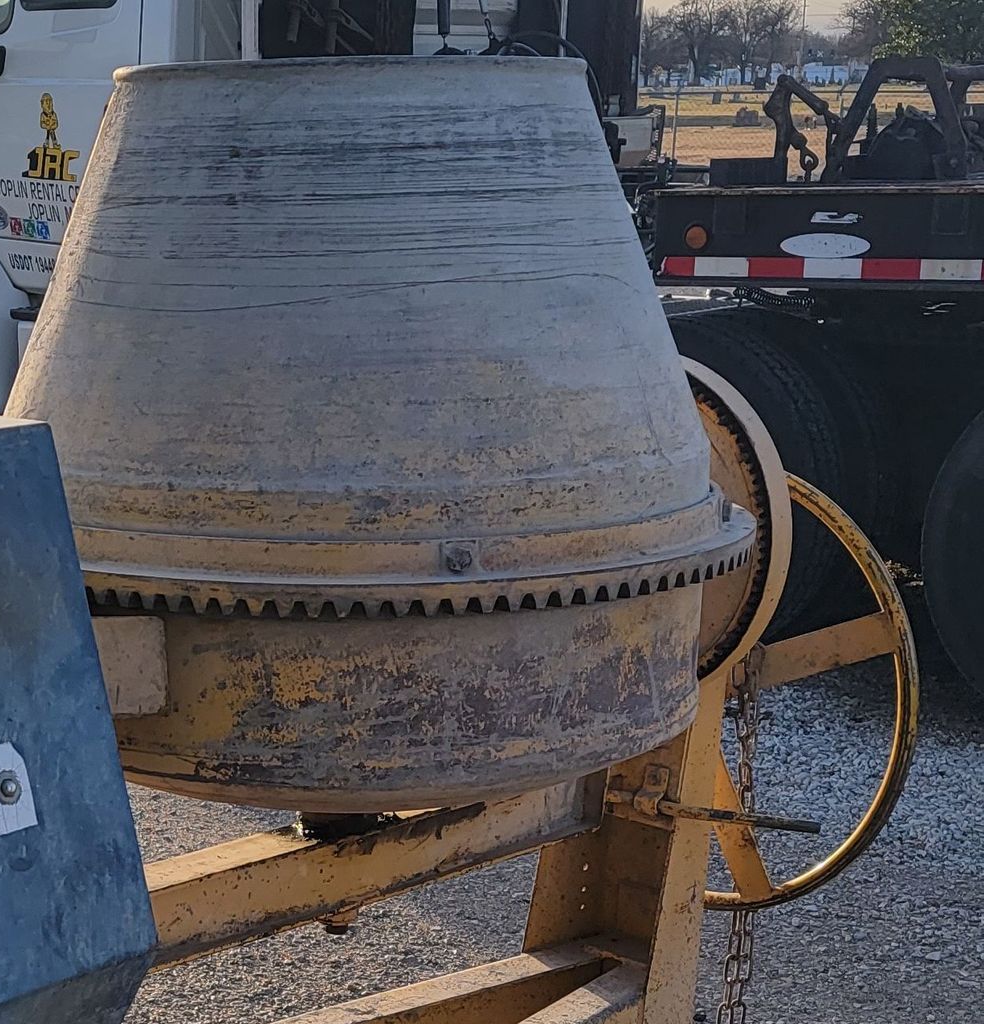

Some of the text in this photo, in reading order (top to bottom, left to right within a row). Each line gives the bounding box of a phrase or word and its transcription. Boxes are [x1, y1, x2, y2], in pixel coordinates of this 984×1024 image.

[30, 182, 67, 202] RENTAL
[28, 203, 64, 225] JOPLIN,
[8, 252, 34, 270] USDOT
